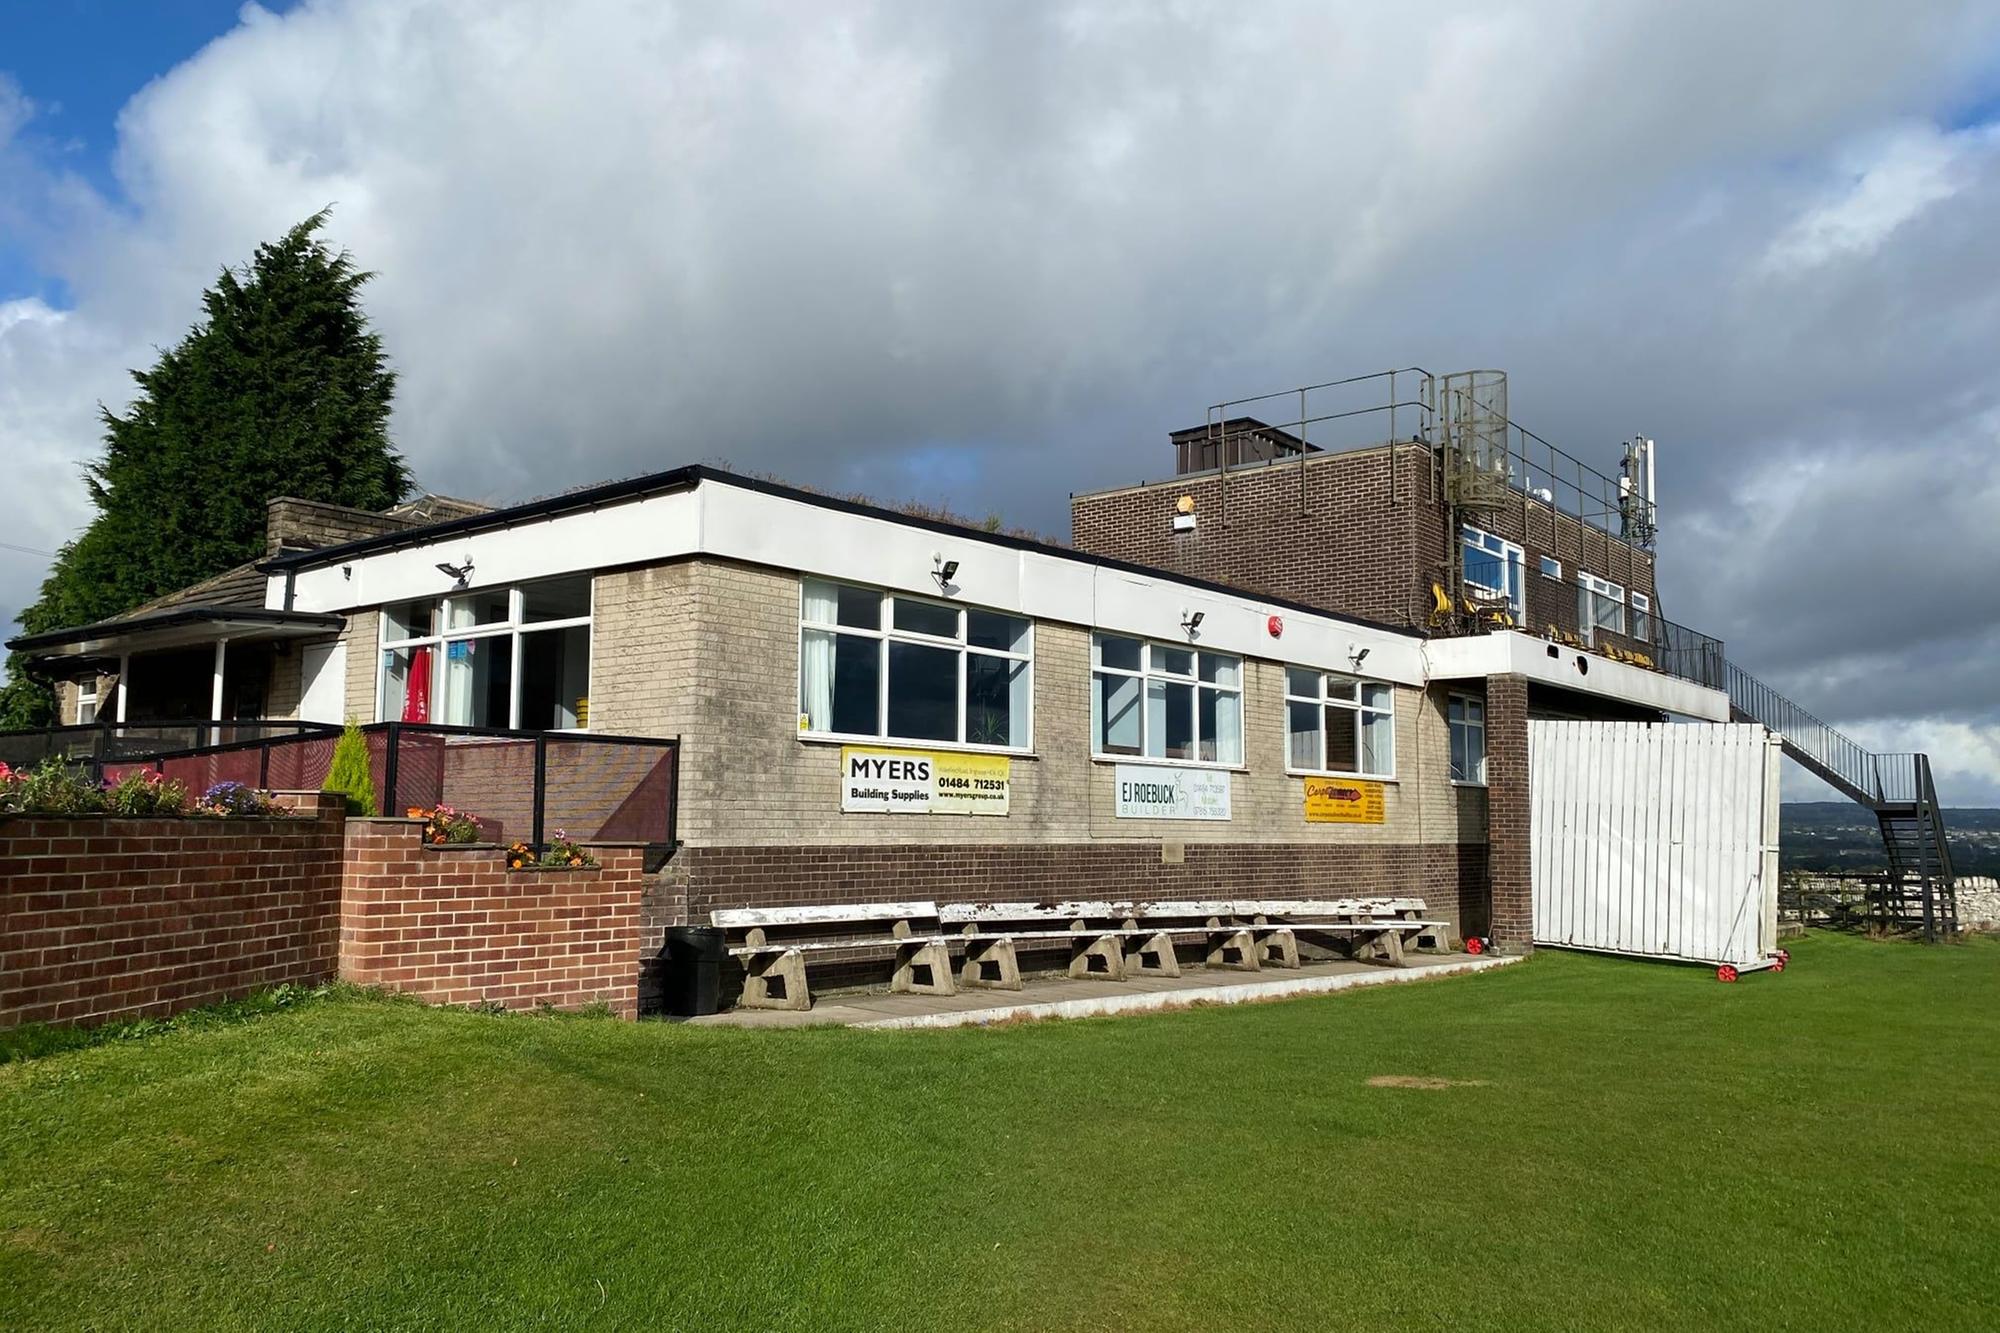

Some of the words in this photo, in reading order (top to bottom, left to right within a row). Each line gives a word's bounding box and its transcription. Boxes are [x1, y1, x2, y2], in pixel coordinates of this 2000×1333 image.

[851, 758, 930, 781] MYERS
[938, 777, 970, 789] 01484
[974, 778, 1005, 790] 712531
[851, 788, 889, 801] Building
[892, 789, 930, 802] Supplies
[1122, 782, 1132, 802] EJ
[1134, 783, 1175, 804] ROEBUCK
[1121, 804, 1176, 816] BUILDER
